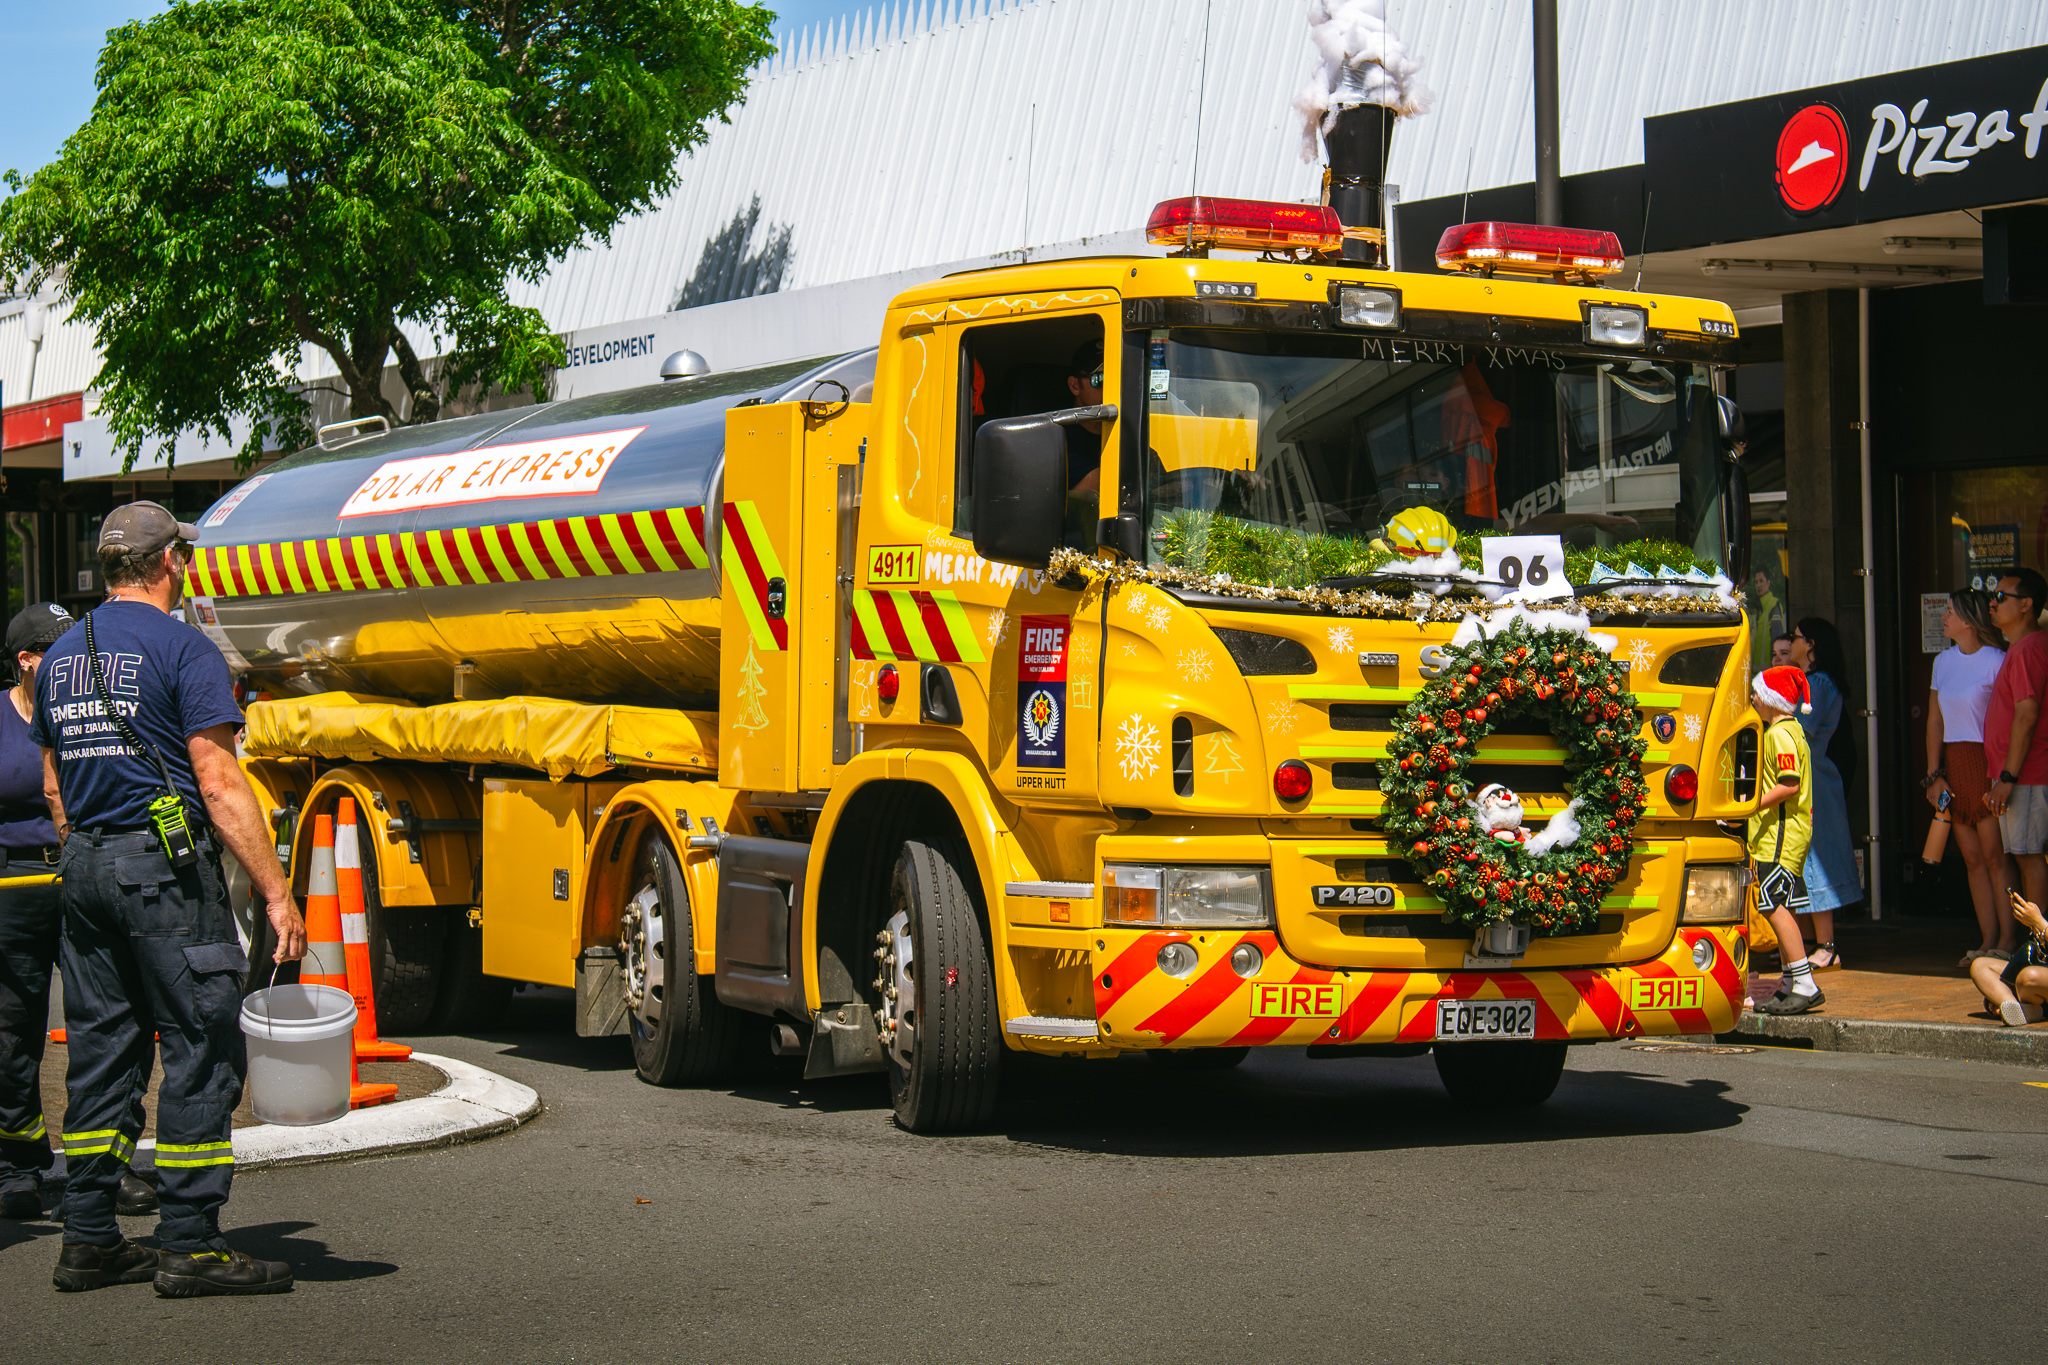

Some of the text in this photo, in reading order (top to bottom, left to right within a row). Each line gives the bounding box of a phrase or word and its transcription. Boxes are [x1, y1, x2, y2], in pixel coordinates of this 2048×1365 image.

[1859, 98, 2015, 192] Pizza
[566, 334, 655, 369] DEVELOPMENT
[1362, 338, 1566, 370] MERRY XMAS
[352, 446, 616, 504] POLAR EXPRESS
[874, 551, 915, 578] 4911
[925, 551, 1044, 595] MERRY XMAS
[1499, 555, 1549, 588] 06
[1025, 628, 1064, 652] FIRE
[1024, 654, 1062, 664] EMERGENCY
[49, 652, 143, 702] FIRE
[62, 724, 83, 737] NEW
[1017, 776, 1067, 790] UPPER HUTT
[1317, 887, 1393, 905] P 420
[1260, 986, 1334, 1016] FIRE
[1441, 1005, 1532, 1035] EQE302
